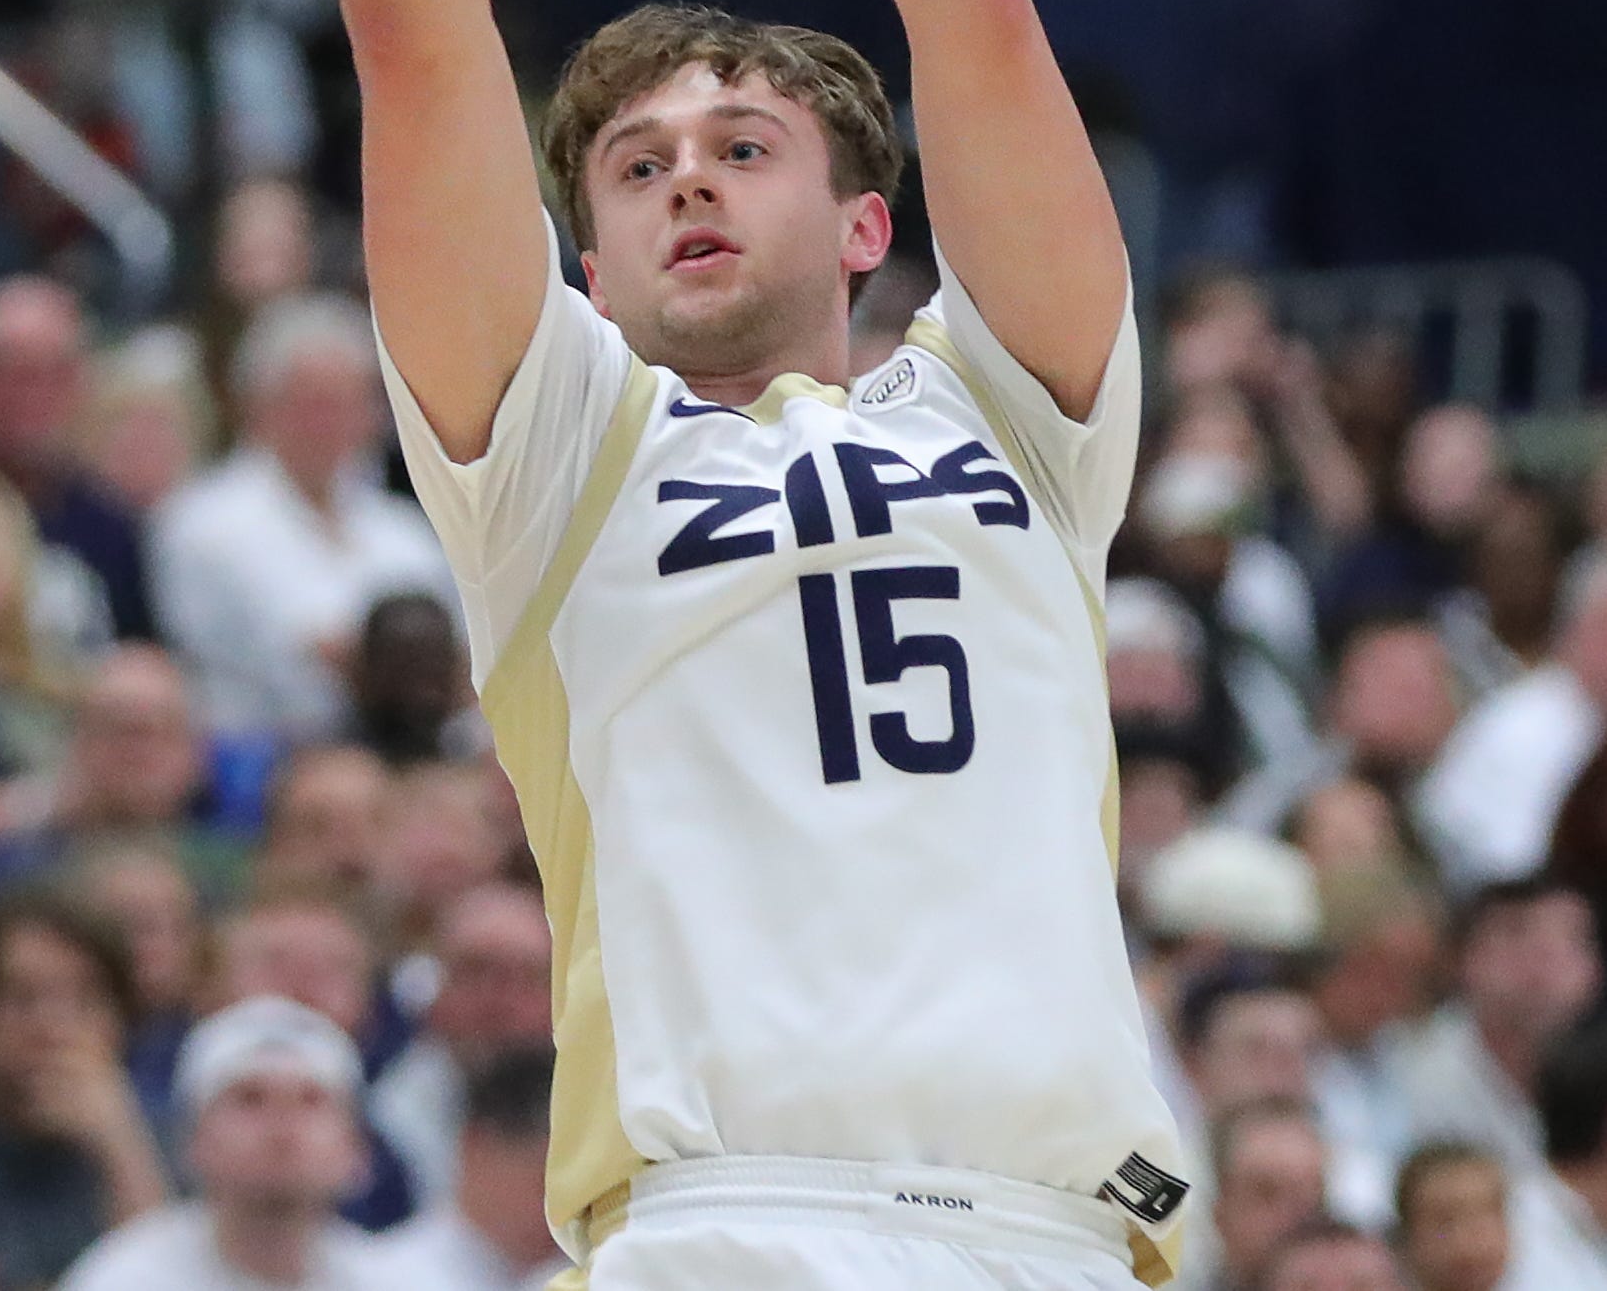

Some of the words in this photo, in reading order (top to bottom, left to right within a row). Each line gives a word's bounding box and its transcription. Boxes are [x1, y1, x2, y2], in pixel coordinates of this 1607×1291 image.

[658, 441, 1029, 576] ZIPS
[798, 566, 975, 784] 15
[895, 1191, 974, 1211] AKRON
